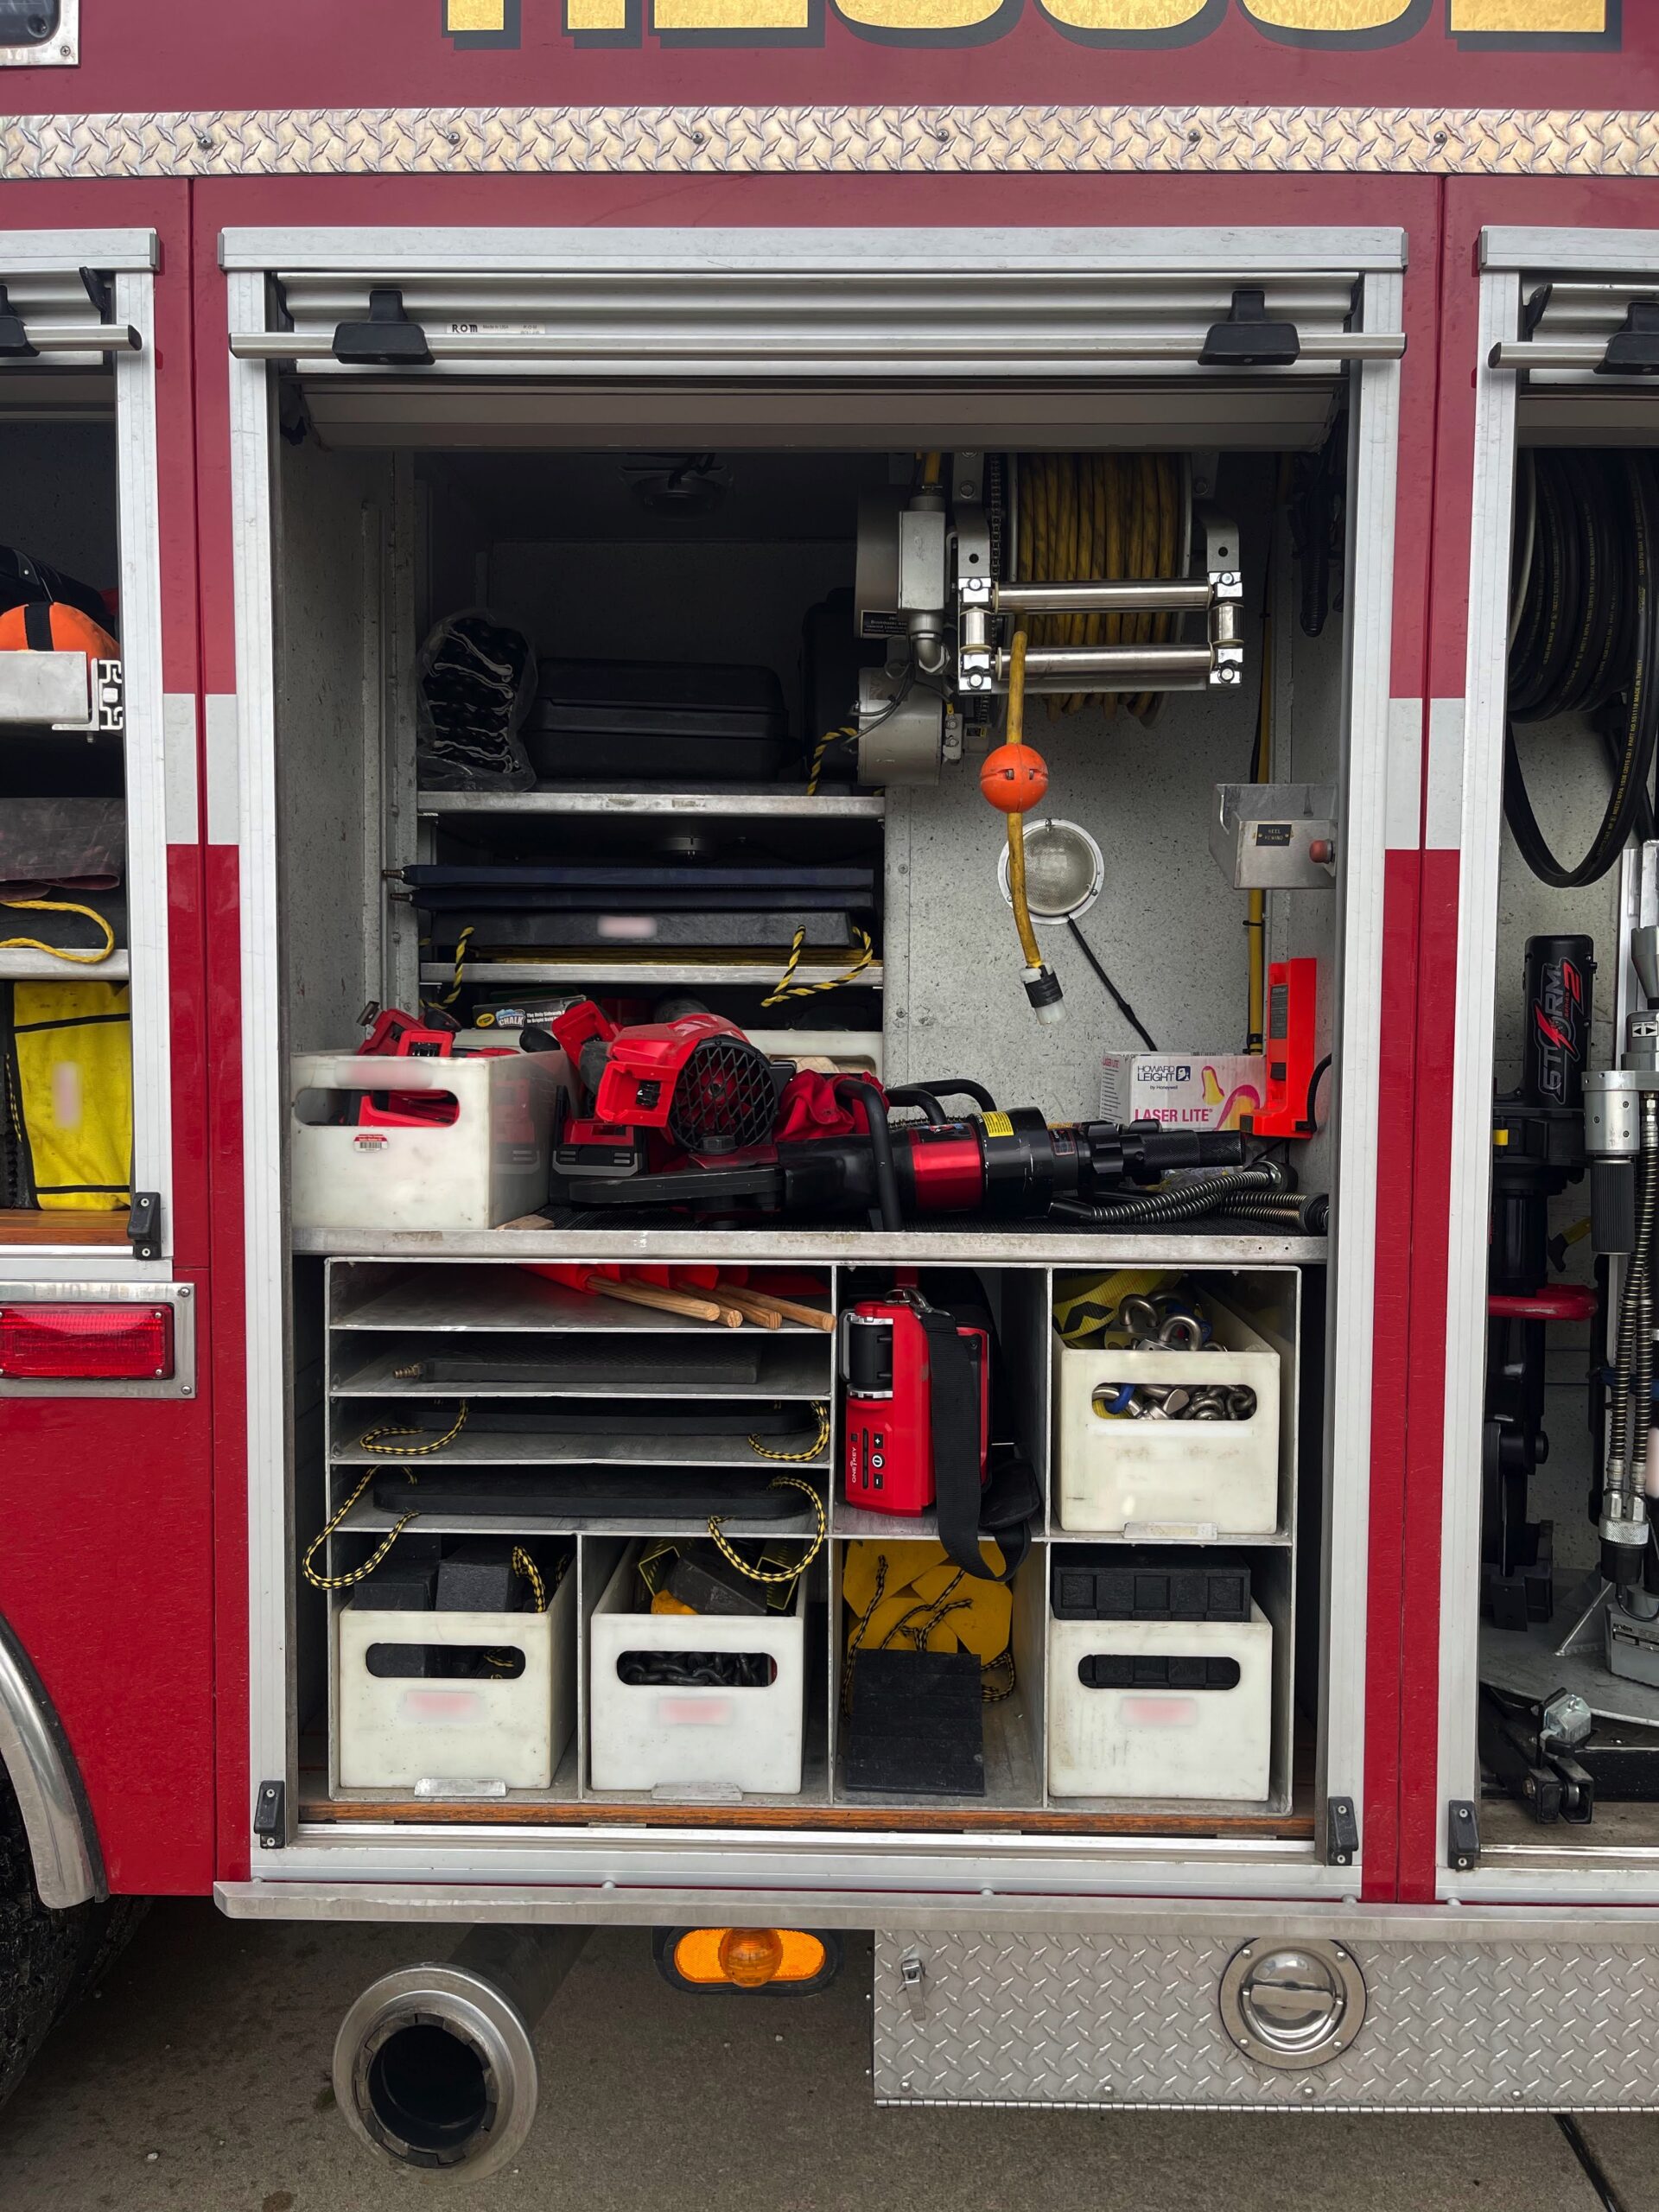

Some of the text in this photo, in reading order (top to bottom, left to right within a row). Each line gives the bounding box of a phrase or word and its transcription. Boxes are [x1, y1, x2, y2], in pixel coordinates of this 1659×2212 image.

[499, 1015, 524, 1027] CHALK
[1137, 1065, 1175, 1073] HOWARD
[1137, 1072, 1175, 1082] LEIGHT
[1135, 1108, 1178, 1122] LASER
